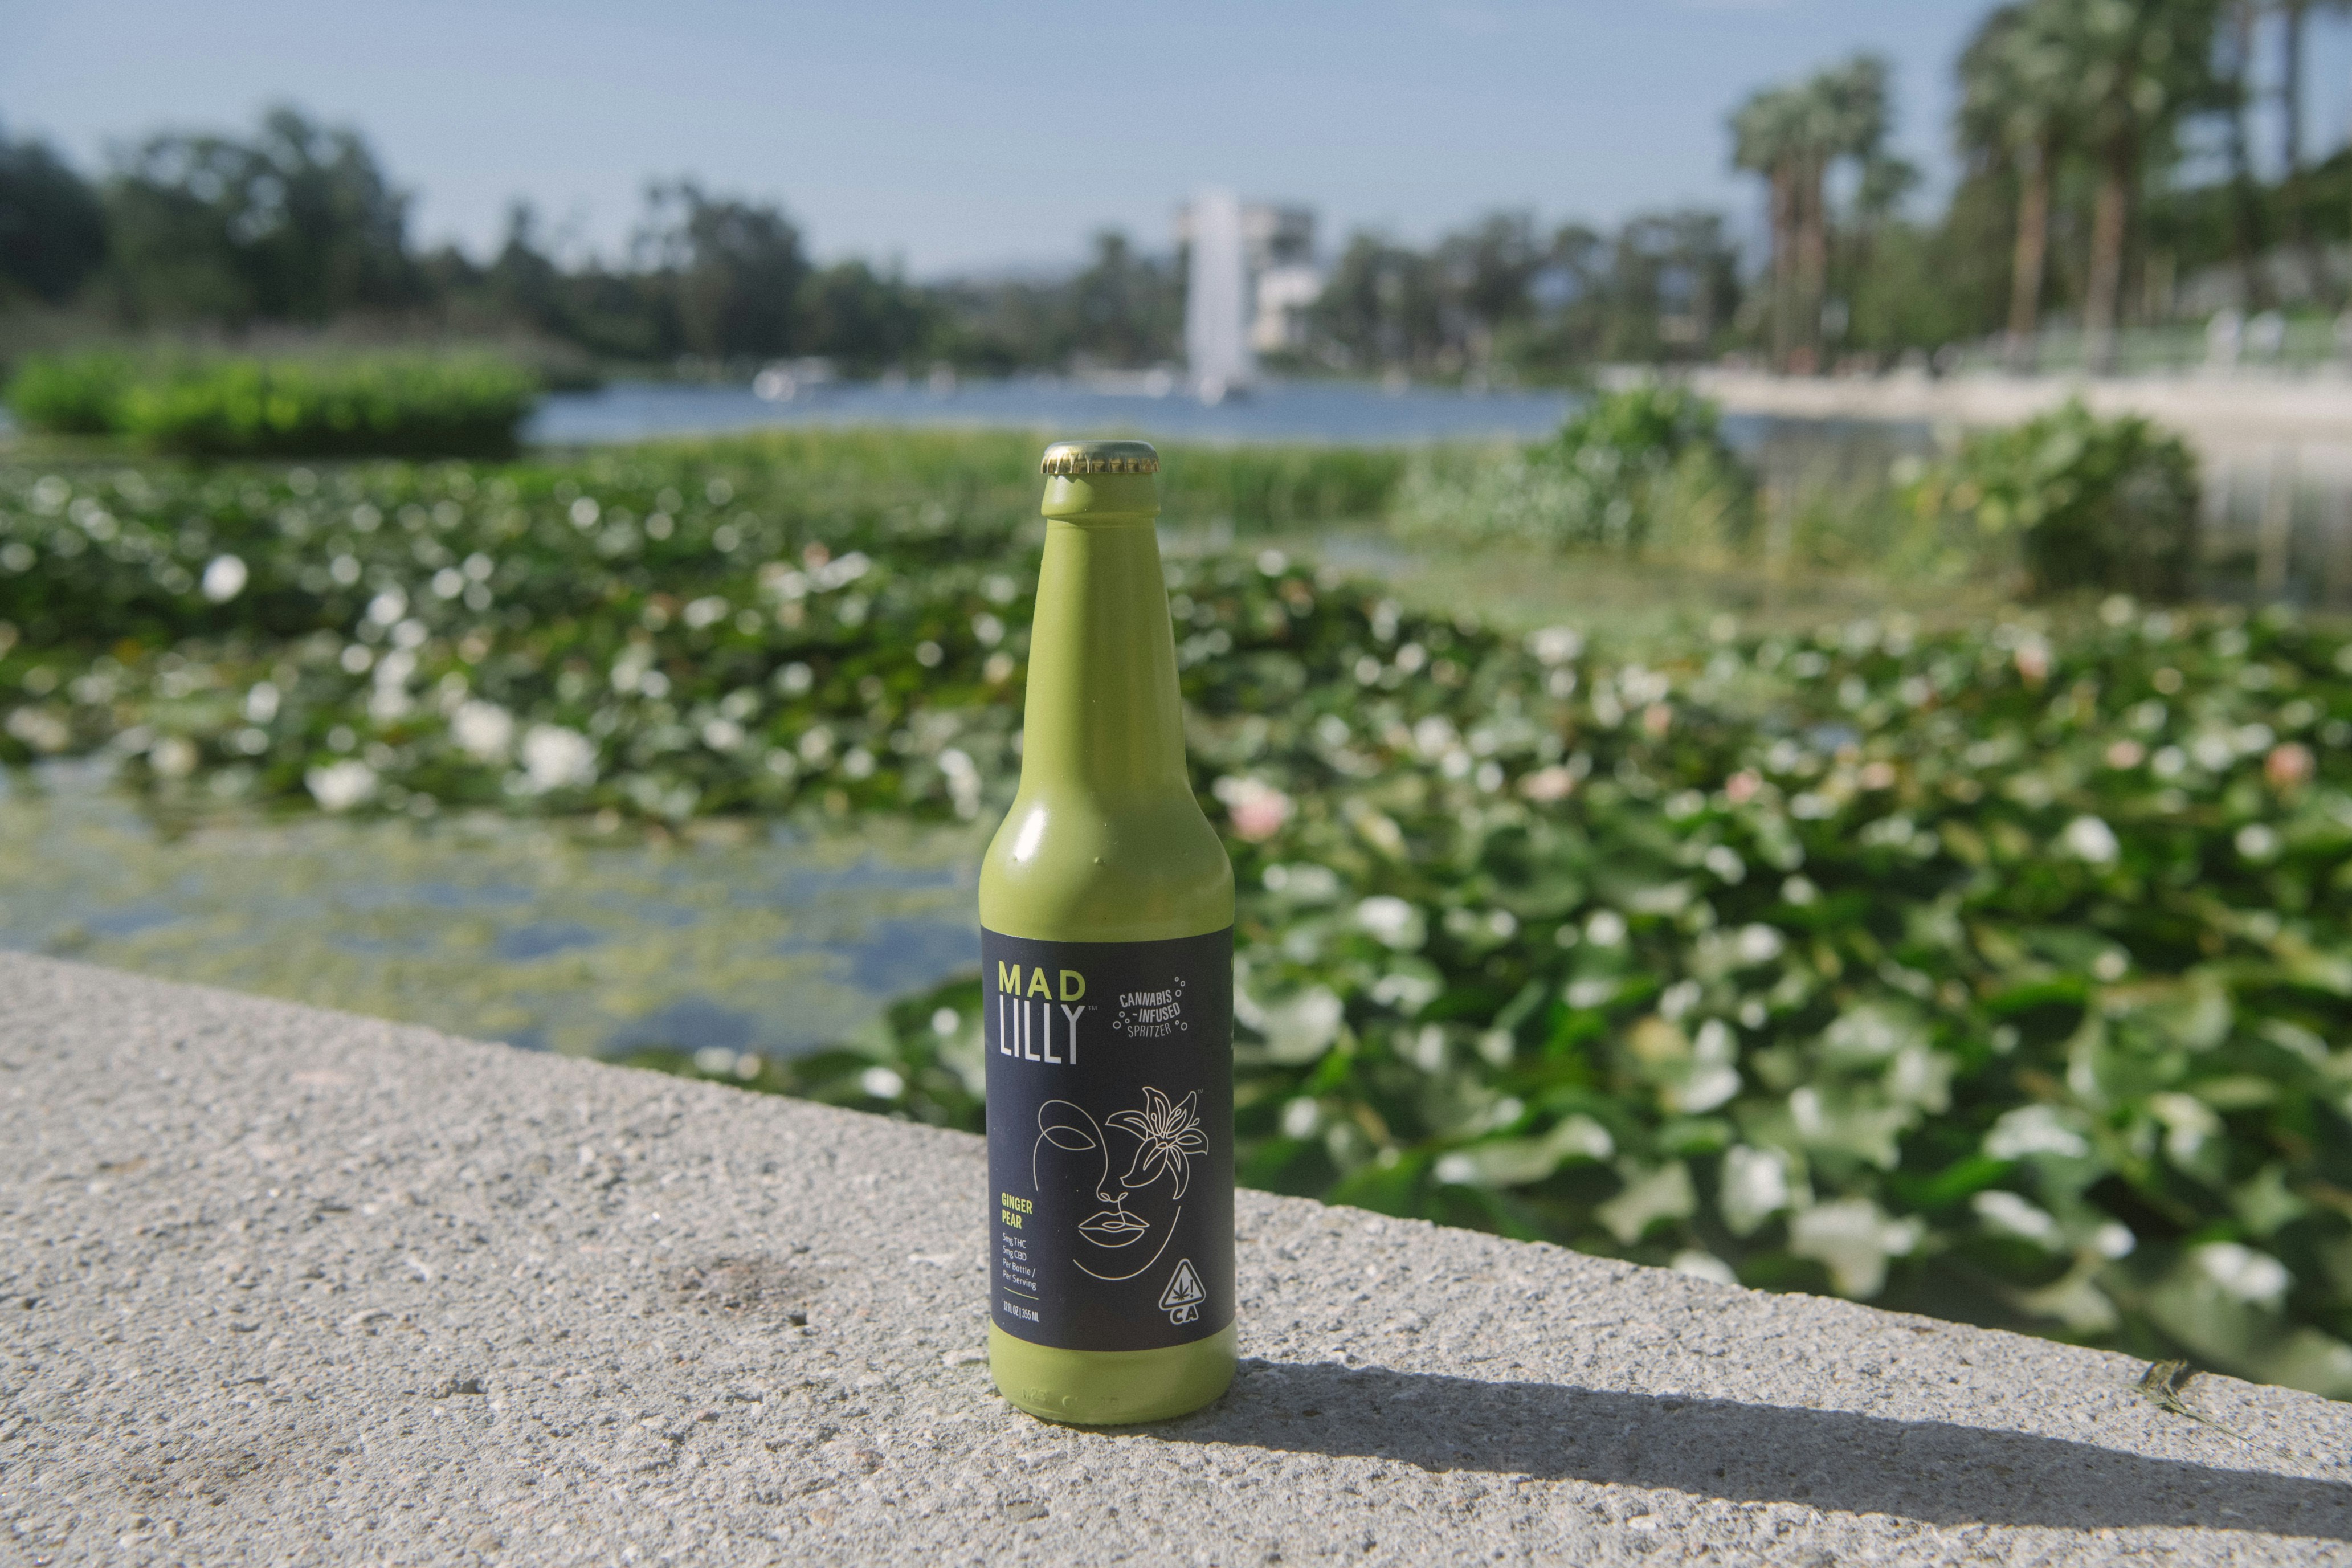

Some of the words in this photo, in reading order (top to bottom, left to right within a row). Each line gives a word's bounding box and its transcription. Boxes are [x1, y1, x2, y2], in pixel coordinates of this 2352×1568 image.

[999, 960, 1086, 1002] MAD
[1120, 989, 1173, 1008] CANNABIS
[999, 994, 1085, 1065] LILLY
[1128, 1023, 1171, 1038] SPRITZER
[1002, 1192, 1032, 1215] GINGER
[1002, 1209, 1022, 1230] PEAR
[1003, 1232, 1014, 1247] 5mg
[1014, 1237, 1026, 1249] THC
[1003, 1245, 1014, 1259] 5mg
[1014, 1250, 1027, 1261] CBD
[1003, 1257, 1011, 1268] Per
[1012, 1262, 1031, 1275] Bottle
[1003, 1269, 1012, 1280] Per
[1012, 1274, 1037, 1291] Serving
[1003, 1300, 1008, 1312] 12
[1008, 1303, 1013, 1314] FL
[1012, 1305, 1019, 1316] OZ
[1022, 1308, 1031, 1320] 355
[1032, 1311, 1040, 1322] ML
[1171, 1305, 1198, 1324] CA
